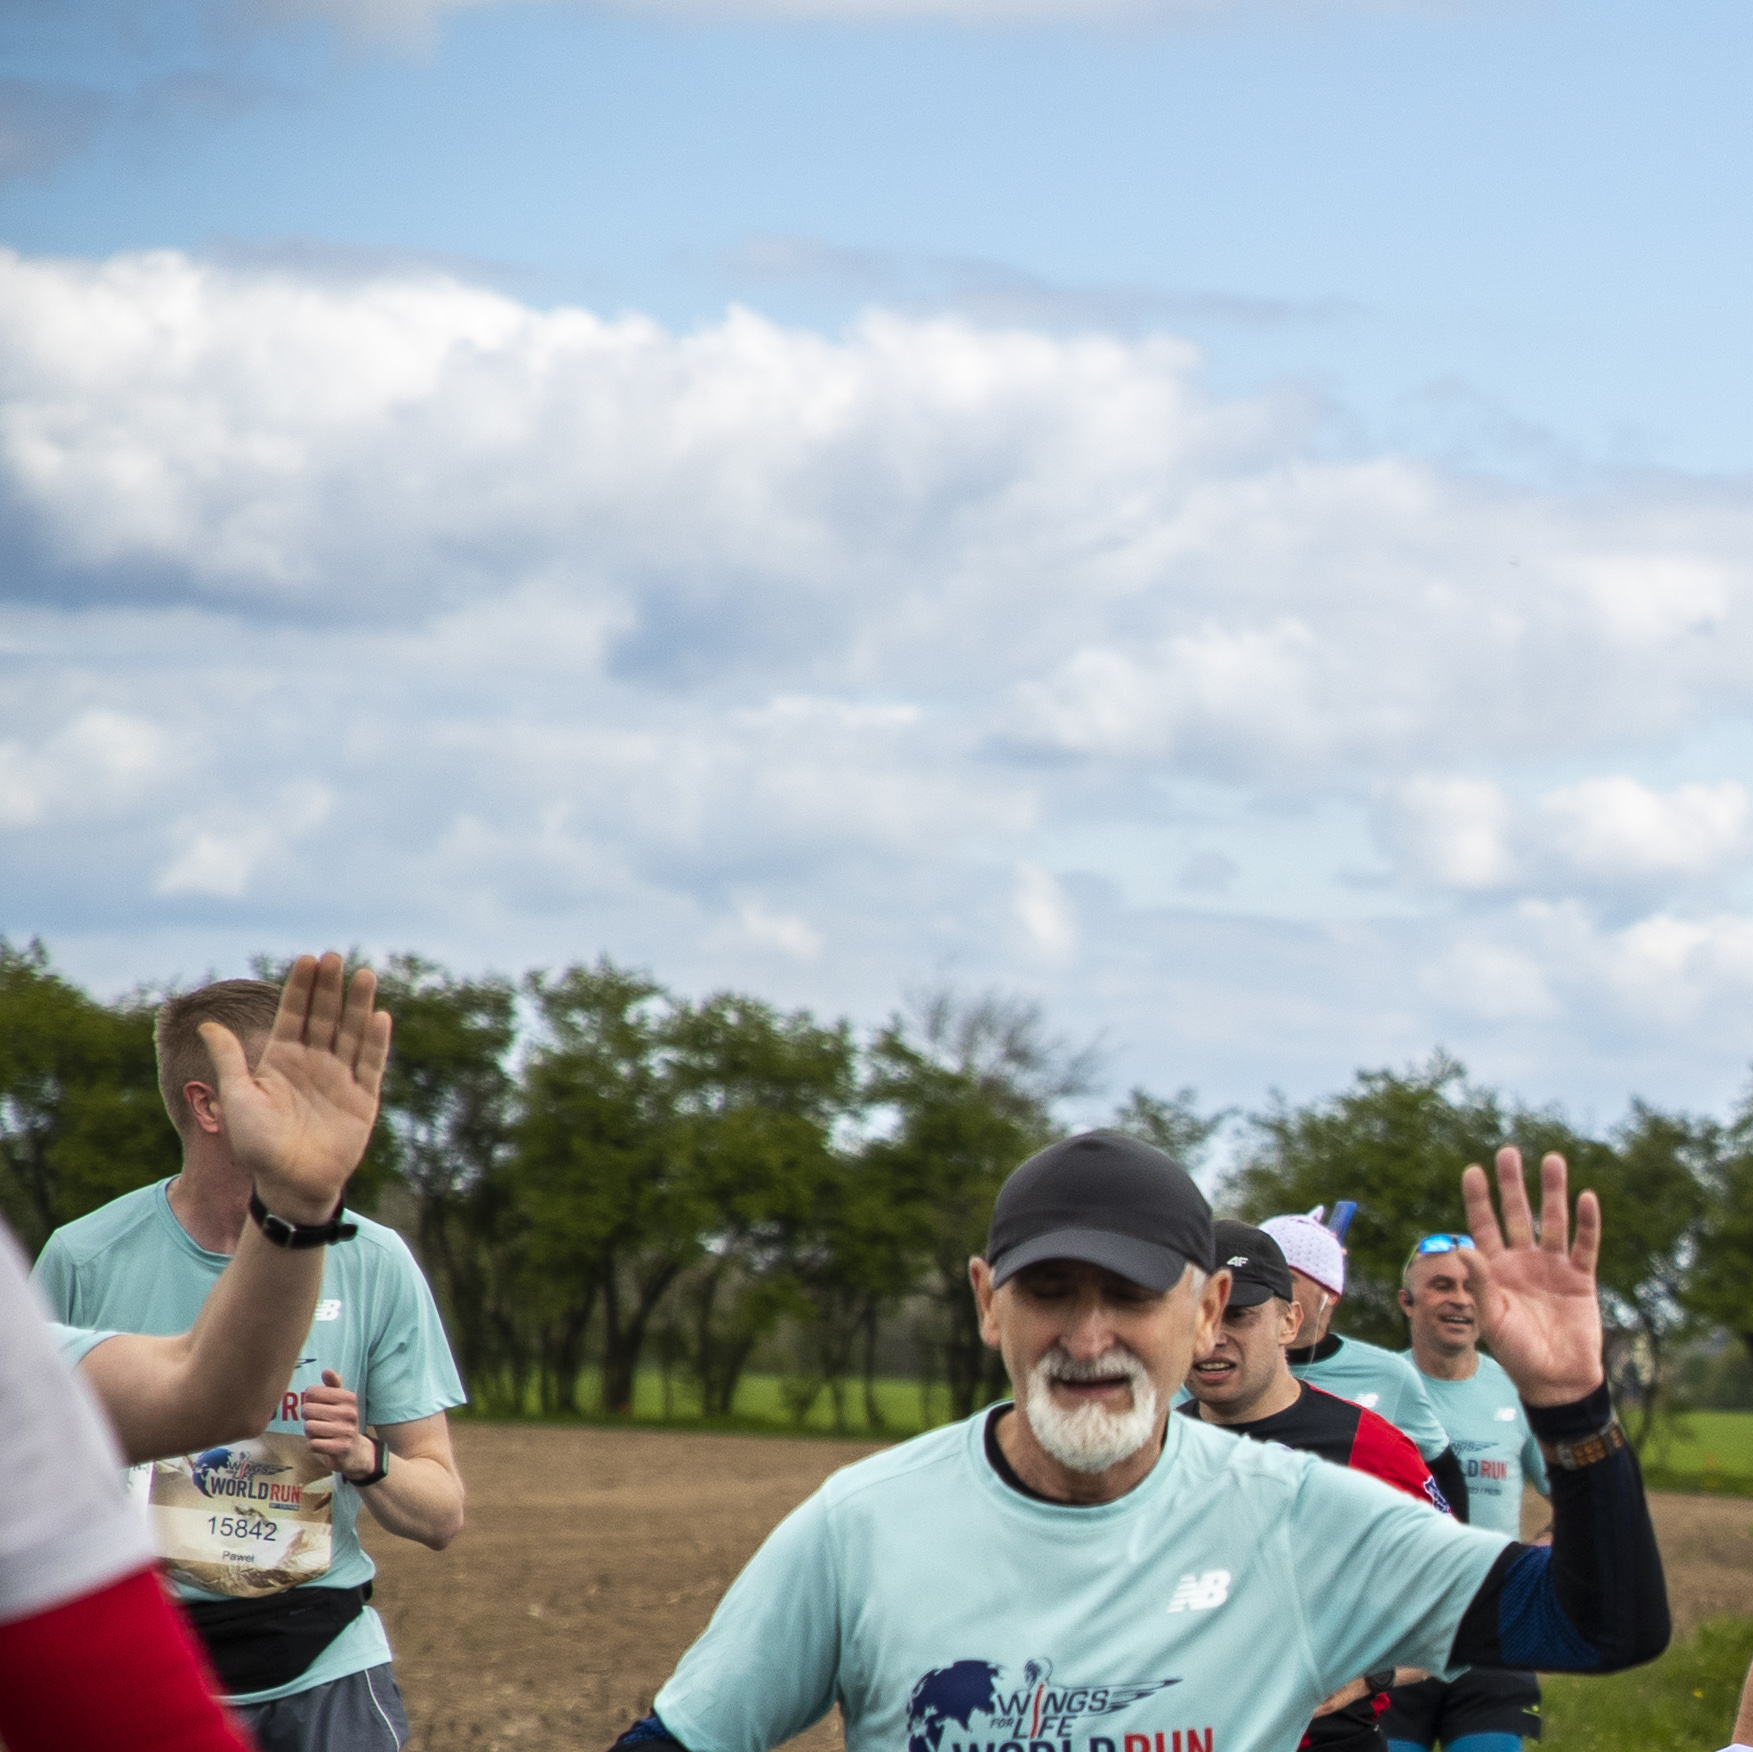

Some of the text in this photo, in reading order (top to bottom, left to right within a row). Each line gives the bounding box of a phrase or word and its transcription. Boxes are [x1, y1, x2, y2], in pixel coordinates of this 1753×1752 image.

[210, 1476, 302, 1503] WORLD RUN
[207, 1516, 277, 1541] 15842
[996, 1686, 1109, 1716] WINGS
[990, 1715, 1078, 1739] FOR LIFE
